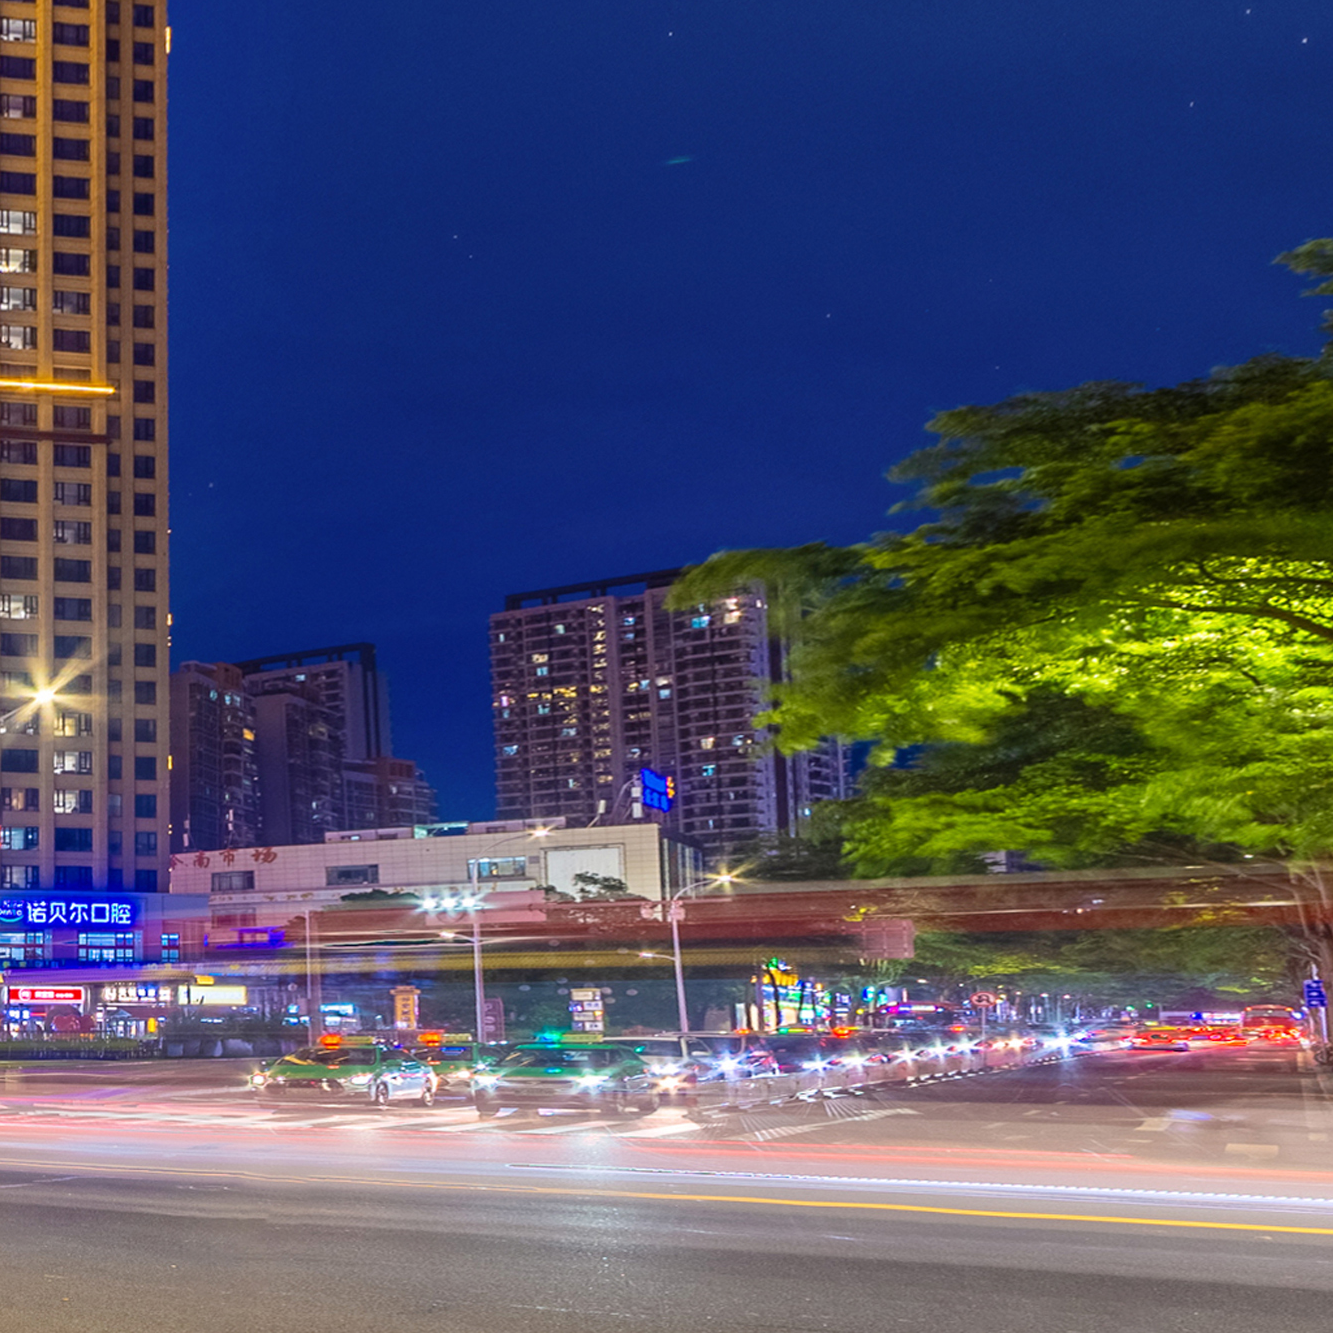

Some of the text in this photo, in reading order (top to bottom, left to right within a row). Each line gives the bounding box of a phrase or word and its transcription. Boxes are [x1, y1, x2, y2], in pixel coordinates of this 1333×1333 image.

[26, 901, 132, 924] 诺贝尔口腔
